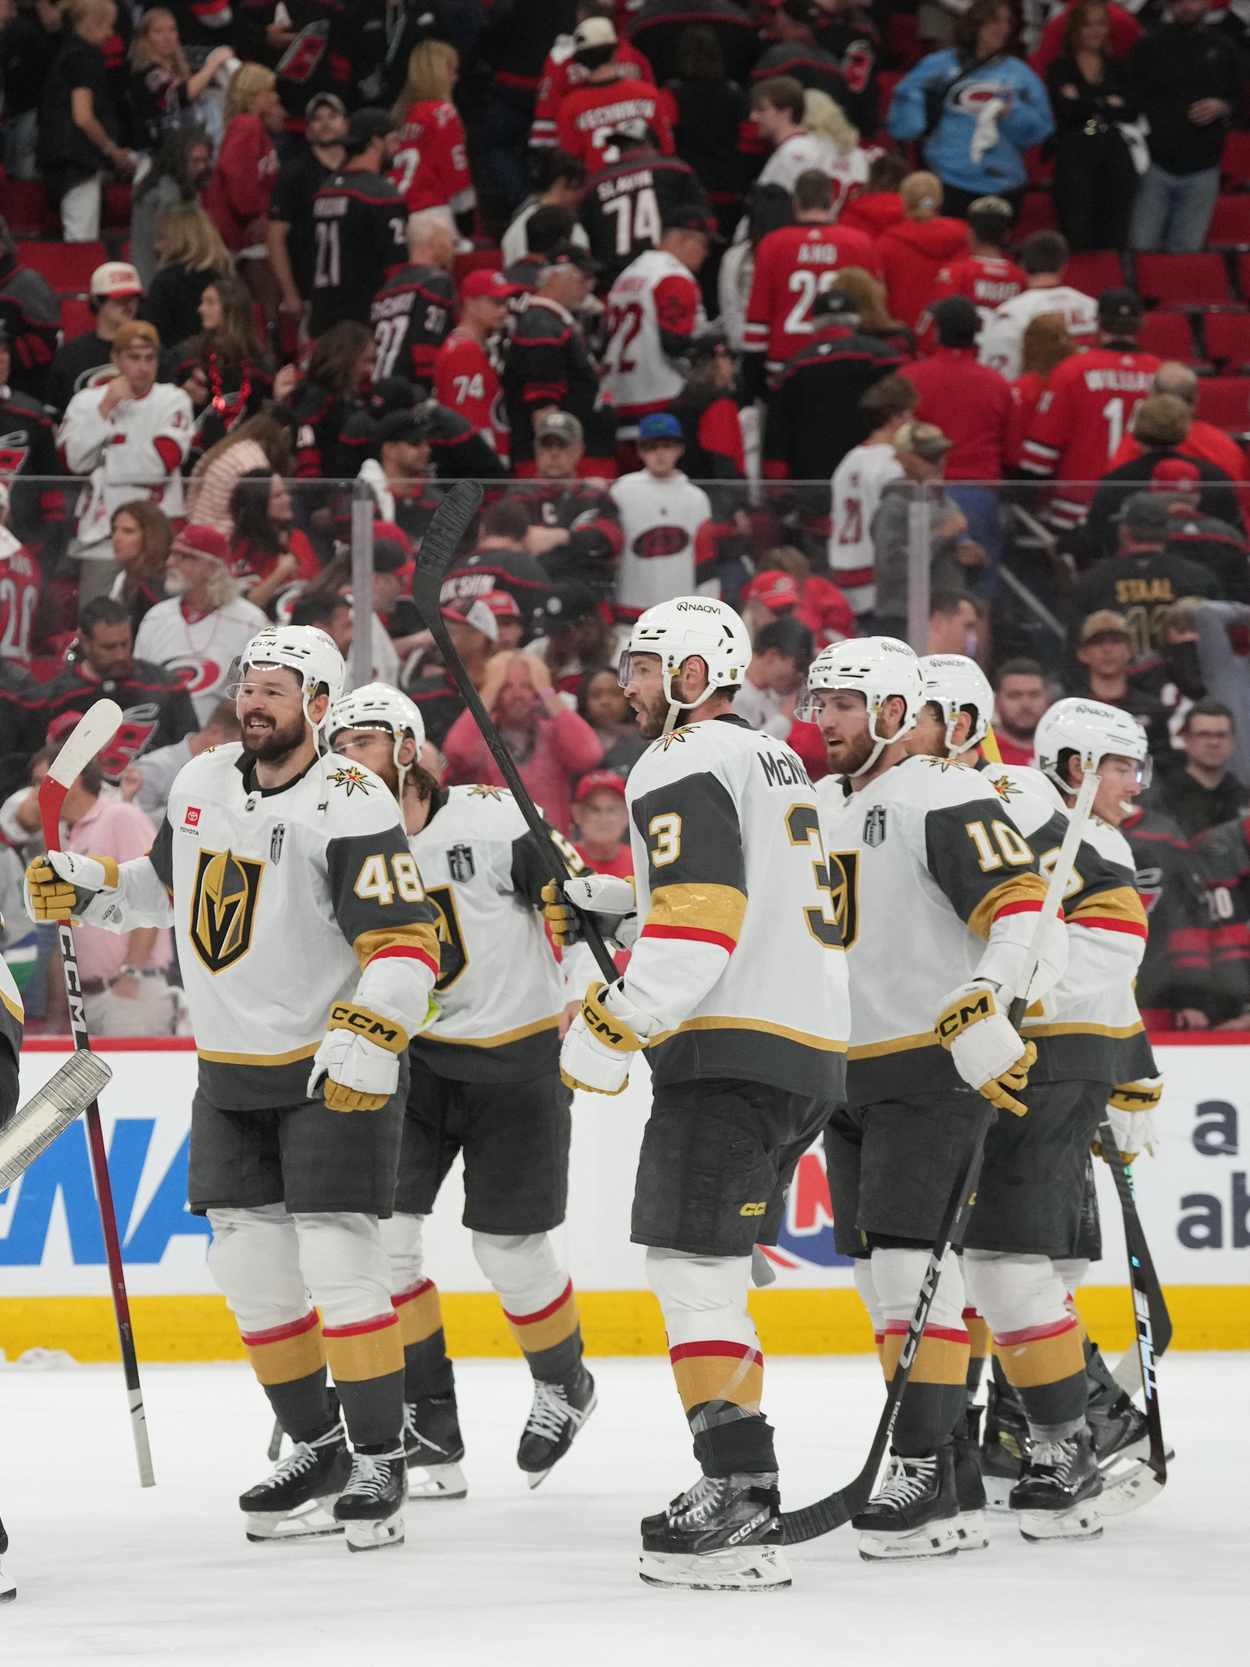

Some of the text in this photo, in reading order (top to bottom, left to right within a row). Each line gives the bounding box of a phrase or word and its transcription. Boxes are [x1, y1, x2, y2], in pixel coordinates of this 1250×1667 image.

[602, 187, 662, 255] 74
[453, 373, 484, 404] 74
[688, 603, 721, 615] NAQVI
[812, 665, 833, 673] CCM
[179, 826, 200, 837] TOYOTA
[648, 812, 682, 868] 3
[964, 819, 1035, 873] 10
[354, 853, 427, 907] 48
[784, 803, 845, 950] 3
[58, 926, 88, 1036] CCM
[332, 1006, 399, 1043] CCM
[582, 1003, 624, 1045] CM
[934, 996, 990, 1038] CM
[899, 1254, 942, 1369] CCM
[1133, 1288, 1155, 1400] TRUE
[728, 1512, 766, 1545] CCM
